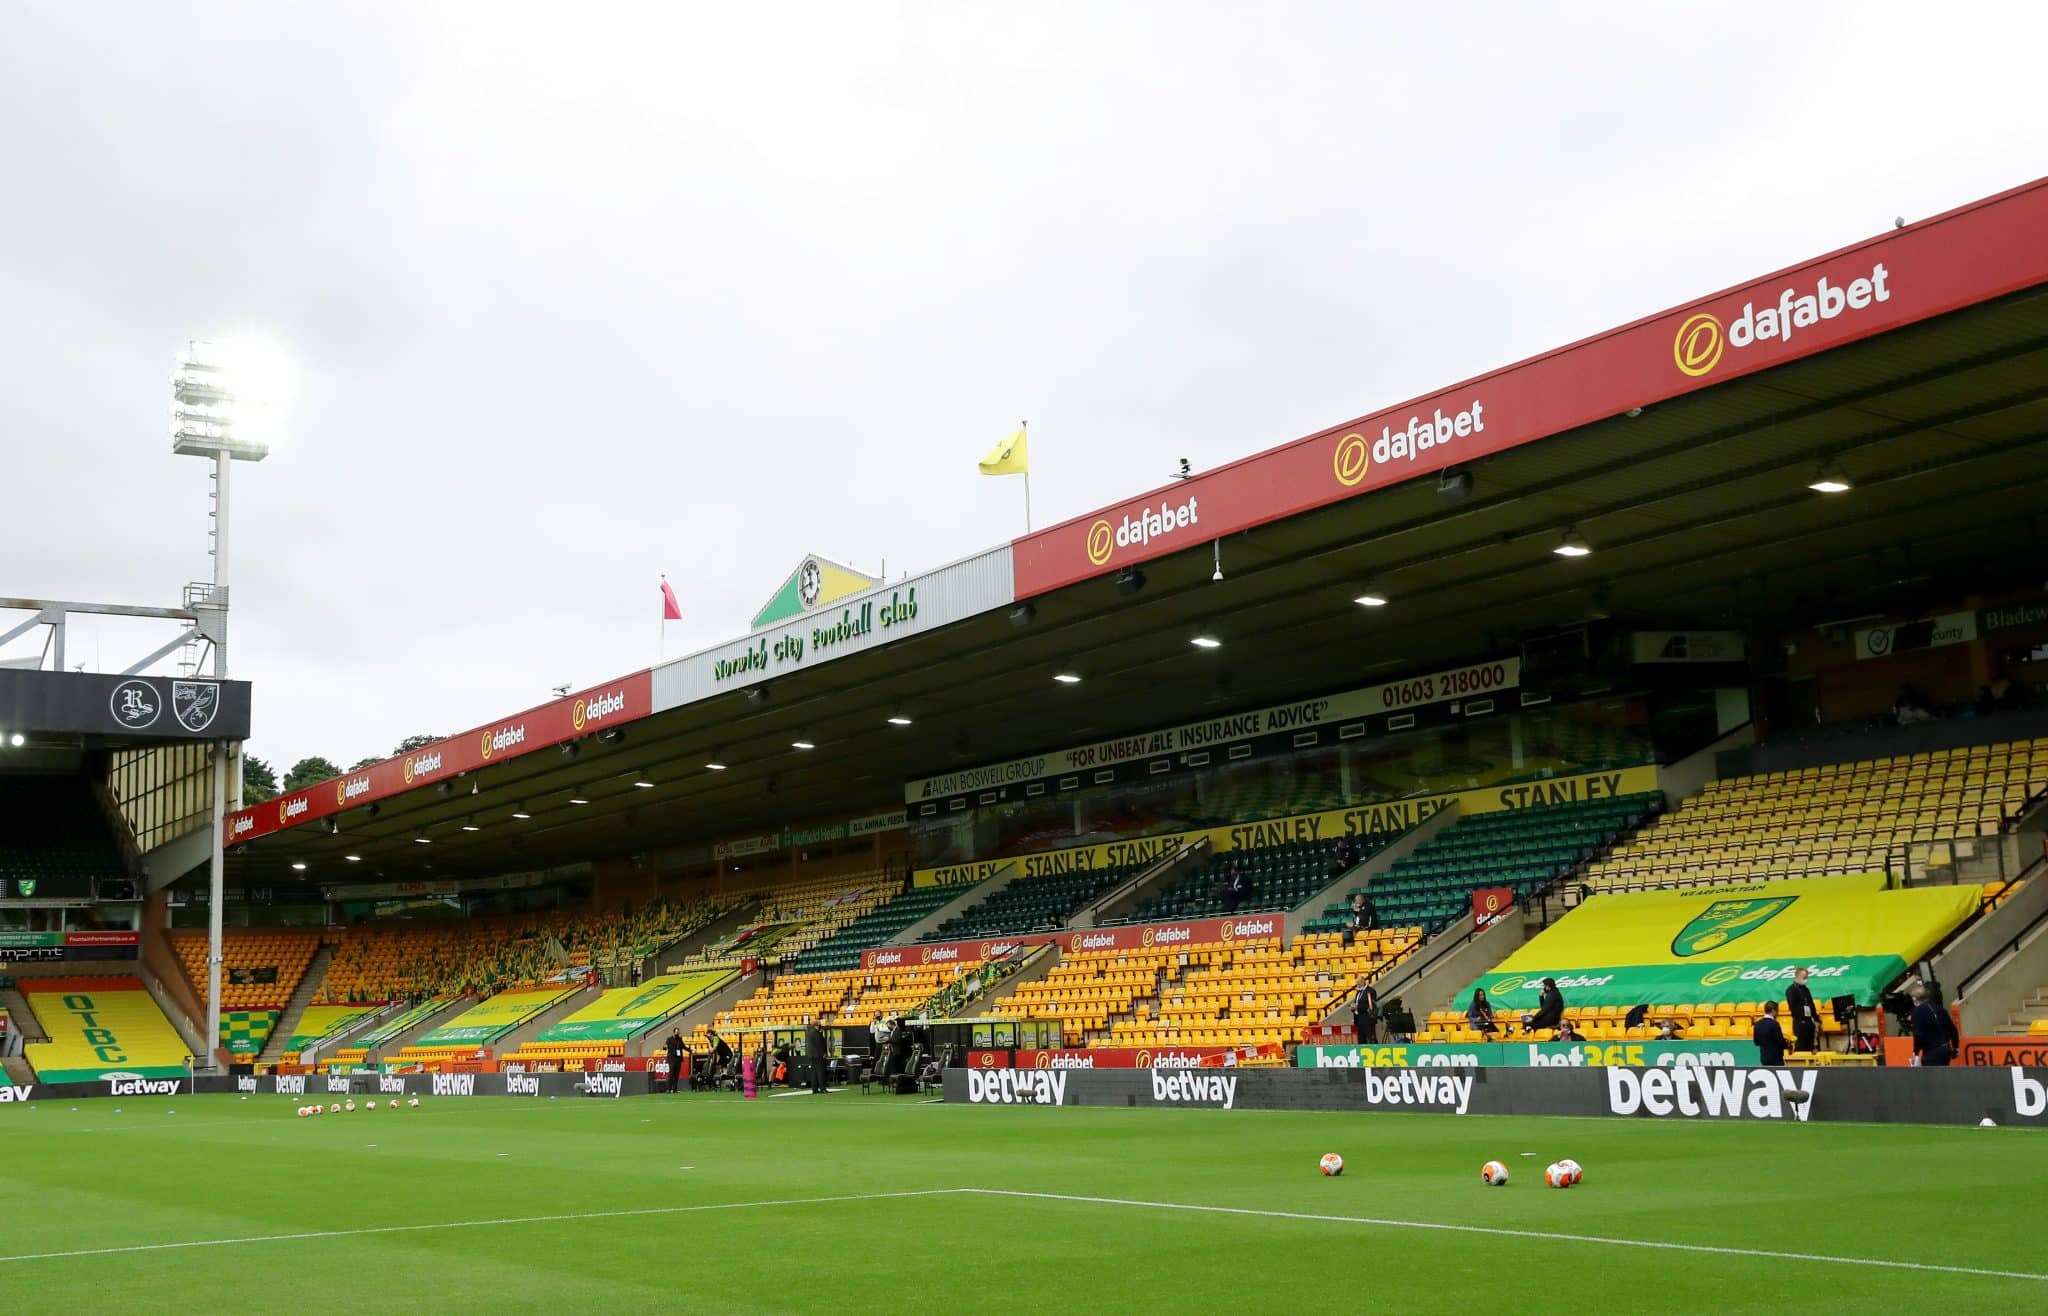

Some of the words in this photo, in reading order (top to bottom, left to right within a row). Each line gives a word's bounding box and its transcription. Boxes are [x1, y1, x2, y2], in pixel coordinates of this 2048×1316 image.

[1729, 263, 1891, 348] dafabet
[1373, 400, 1485, 464] dafabet
[1116, 495, 1199, 547] dafabet
[714, 637, 768, 680] Norwich
[774, 634, 804, 661] City
[811, 601, 873, 650] Football
[880, 587, 918, 627] Club
[586, 691, 625, 721] dafabet
[493, 724, 525, 751] dafabet
[931, 779, 957, 793] ALAN
[1099, 732, 1173, 763] UNBEATLE
[1179, 714, 1260, 748] INSURANCE
[1382, 678, 1434, 707] 01603
[1440, 664, 1505, 697] 218000
[414, 752, 442, 777] dafabet
[345, 776, 370, 798] dafabet
[1500, 773, 1621, 810] STANLEY
[286, 798, 308, 818] dafabet
[234, 816, 254, 834] dafabet
[1231, 816, 1322, 851] STANLEY
[1025, 848, 1096, 880] STANLEY
[1156, 928, 1190, 943] dafabet
[1235, 920, 1274, 937] dafabet
[1082, 934, 1115, 949] dafabet
[877, 952, 901, 966] dafabet
[932, 947, 958, 961] dafabet
[1522, 974, 1614, 989] dfabet
[604, 1062, 626, 1072] dafabet
[1051, 1052, 1094, 1068] dafabet
[1153, 1052, 1202, 1068] dafabet
[111, 1080, 180, 1095] betway
[238, 1075, 257, 1094] betway
[276, 1075, 305, 1095] betway
[328, 1074, 350, 1095] betway
[380, 1074, 405, 1095] betway
[432, 1073, 475, 1096] betway
[506, 1072, 539, 1096] betway
[584, 1072, 622, 1098] betway
[968, 1069, 1067, 1106] betway
[1151, 1068, 1237, 1109] betway
[1365, 1067, 1473, 1115] betway
[1607, 1066, 1818, 1121] betway
